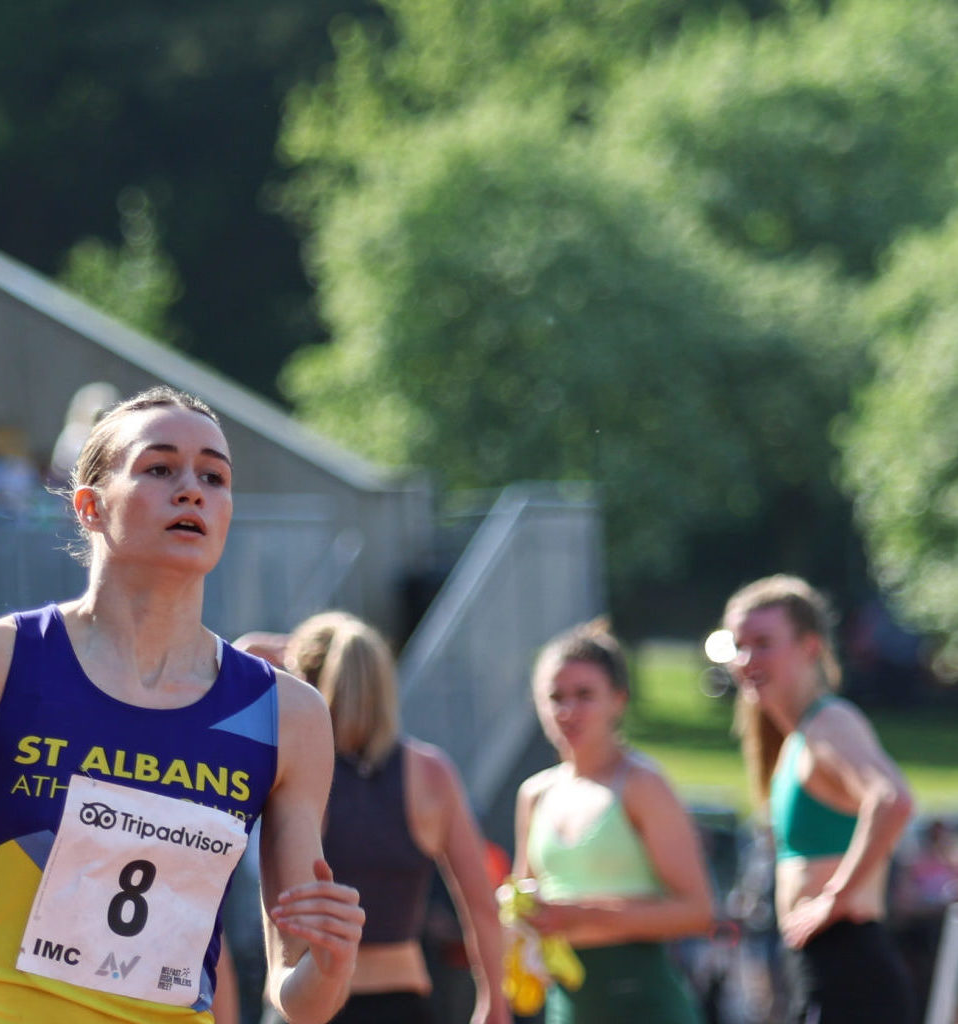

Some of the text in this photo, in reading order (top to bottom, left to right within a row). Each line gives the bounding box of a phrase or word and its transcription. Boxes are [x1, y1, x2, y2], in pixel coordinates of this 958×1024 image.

[14, 735, 68, 767] ST
[80, 745, 250, 801] ALBANS
[120, 811, 233, 856] Tripadvisor
[107, 859, 157, 937] 8
[32, 938, 82, 966] IMC
